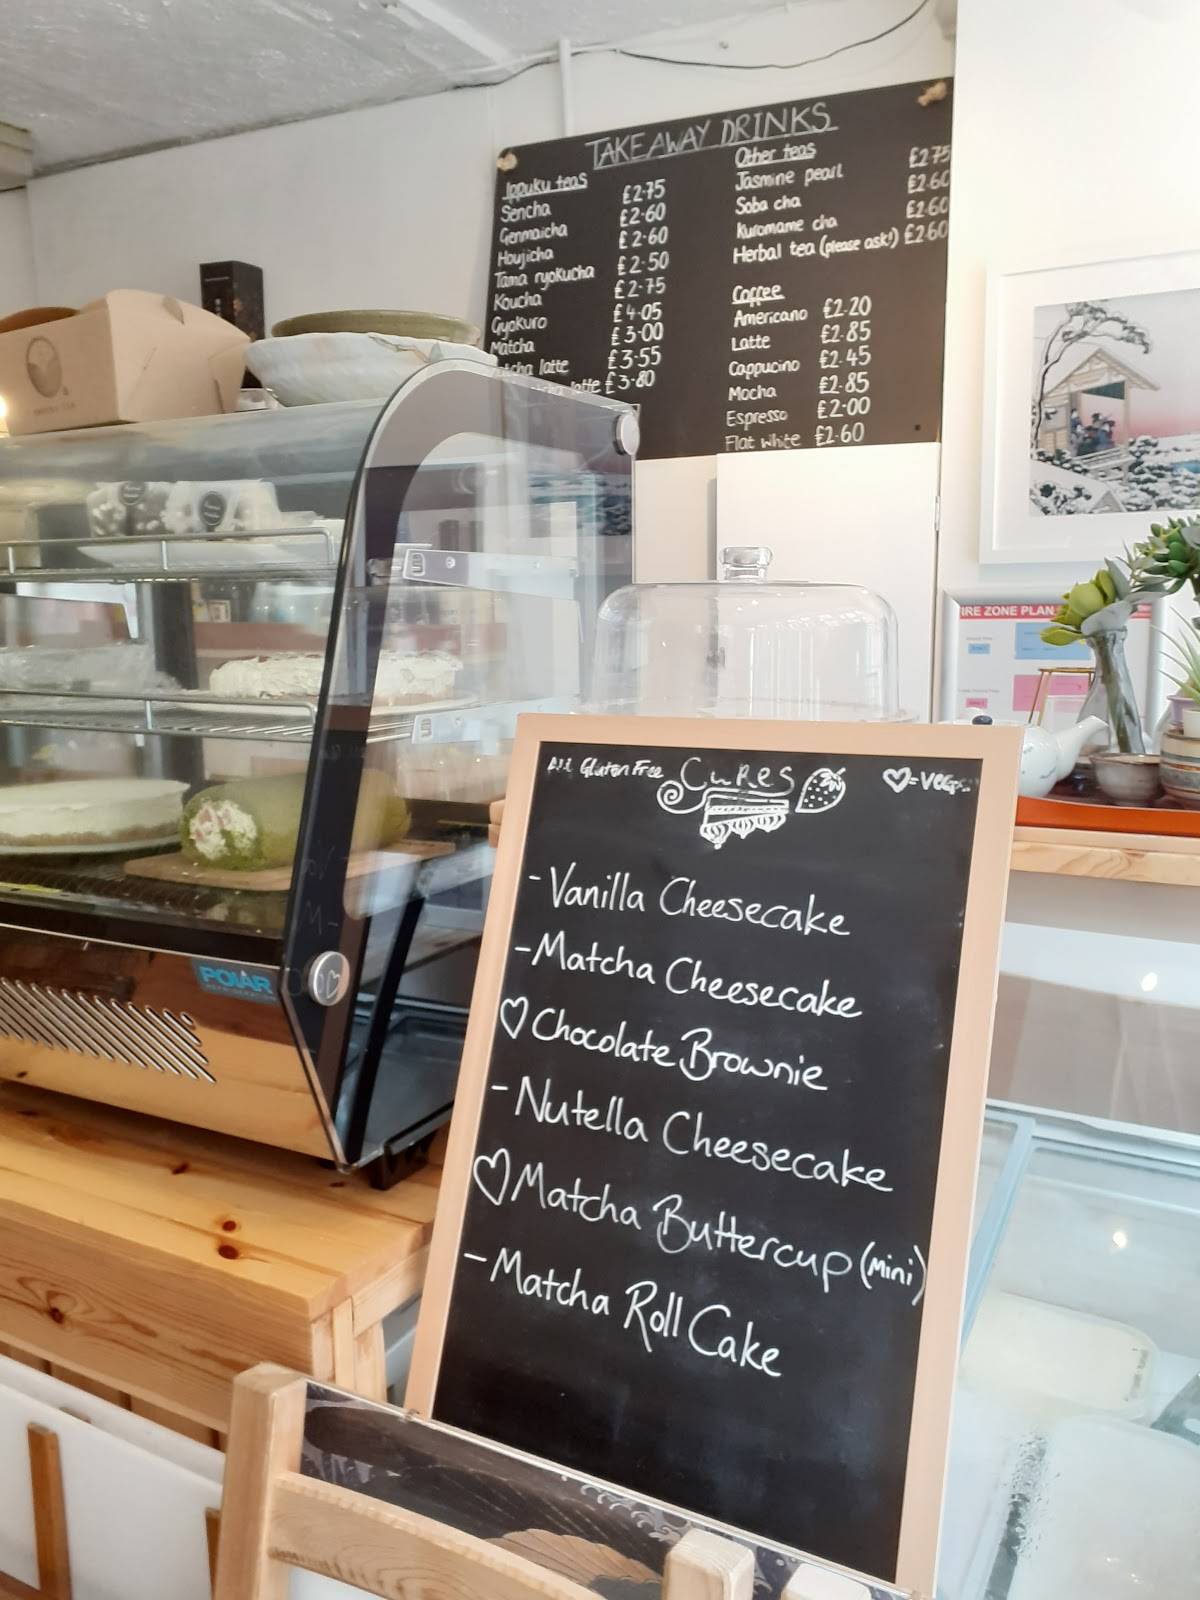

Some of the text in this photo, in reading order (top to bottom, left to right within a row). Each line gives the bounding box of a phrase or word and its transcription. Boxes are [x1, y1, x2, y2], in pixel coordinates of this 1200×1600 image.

[720, 101, 832, 145] DRINKS
[735, 142, 817, 168] Other teas
[555, 172, 588, 191] teas
[735, 170, 795, 191] Jasmine
[804, 163, 844, 187] pearl
[500, 200, 552, 223] Sencha
[735, 194, 769, 215] Soba
[773, 195, 802, 210] cha
[812, 214, 838, 231] cha
[500, 222, 568, 246] Genmaicha
[497, 246, 554, 270] Houjicha
[733, 242, 782, 264] Herbal
[789, 240, 816, 257] tea
[494, 271, 528, 289] Tama
[493, 292, 543, 311] Koucha
[731, 284, 785, 307] Coffee
[491, 316, 548, 339] Gyokuro
[733, 308, 808, 328] Americano
[490, 338, 536, 356] Matcha
[731, 334, 771, 351] Latte
[538, 358, 570, 376] latte
[728, 359, 800, 379] Cappucino
[728, 384, 777, 401] Mocha
[726, 409, 788, 431] Espresso
[725, 434, 755, 451] Flat
[760, 432, 801, 449] white
[960, 604, 1055, 617] IRE ZONE PLAN
[580, 757, 629, 778] Gluten
[632, 759, 664, 779] Free
[550, 861, 850, 936] Vanilla Cheesecake
[531, 930, 863, 1018] Matcha Cheesecake
[531, 1007, 829, 1091] Chocolate Brownie
[514, 1075, 894, 1193] Nutella Cheesecake
[510, 1162, 642, 1231] Matcha
[653, 1192, 853, 1293] Buttercup
[489, 1247, 783, 1378] Matcha Roll Cake
